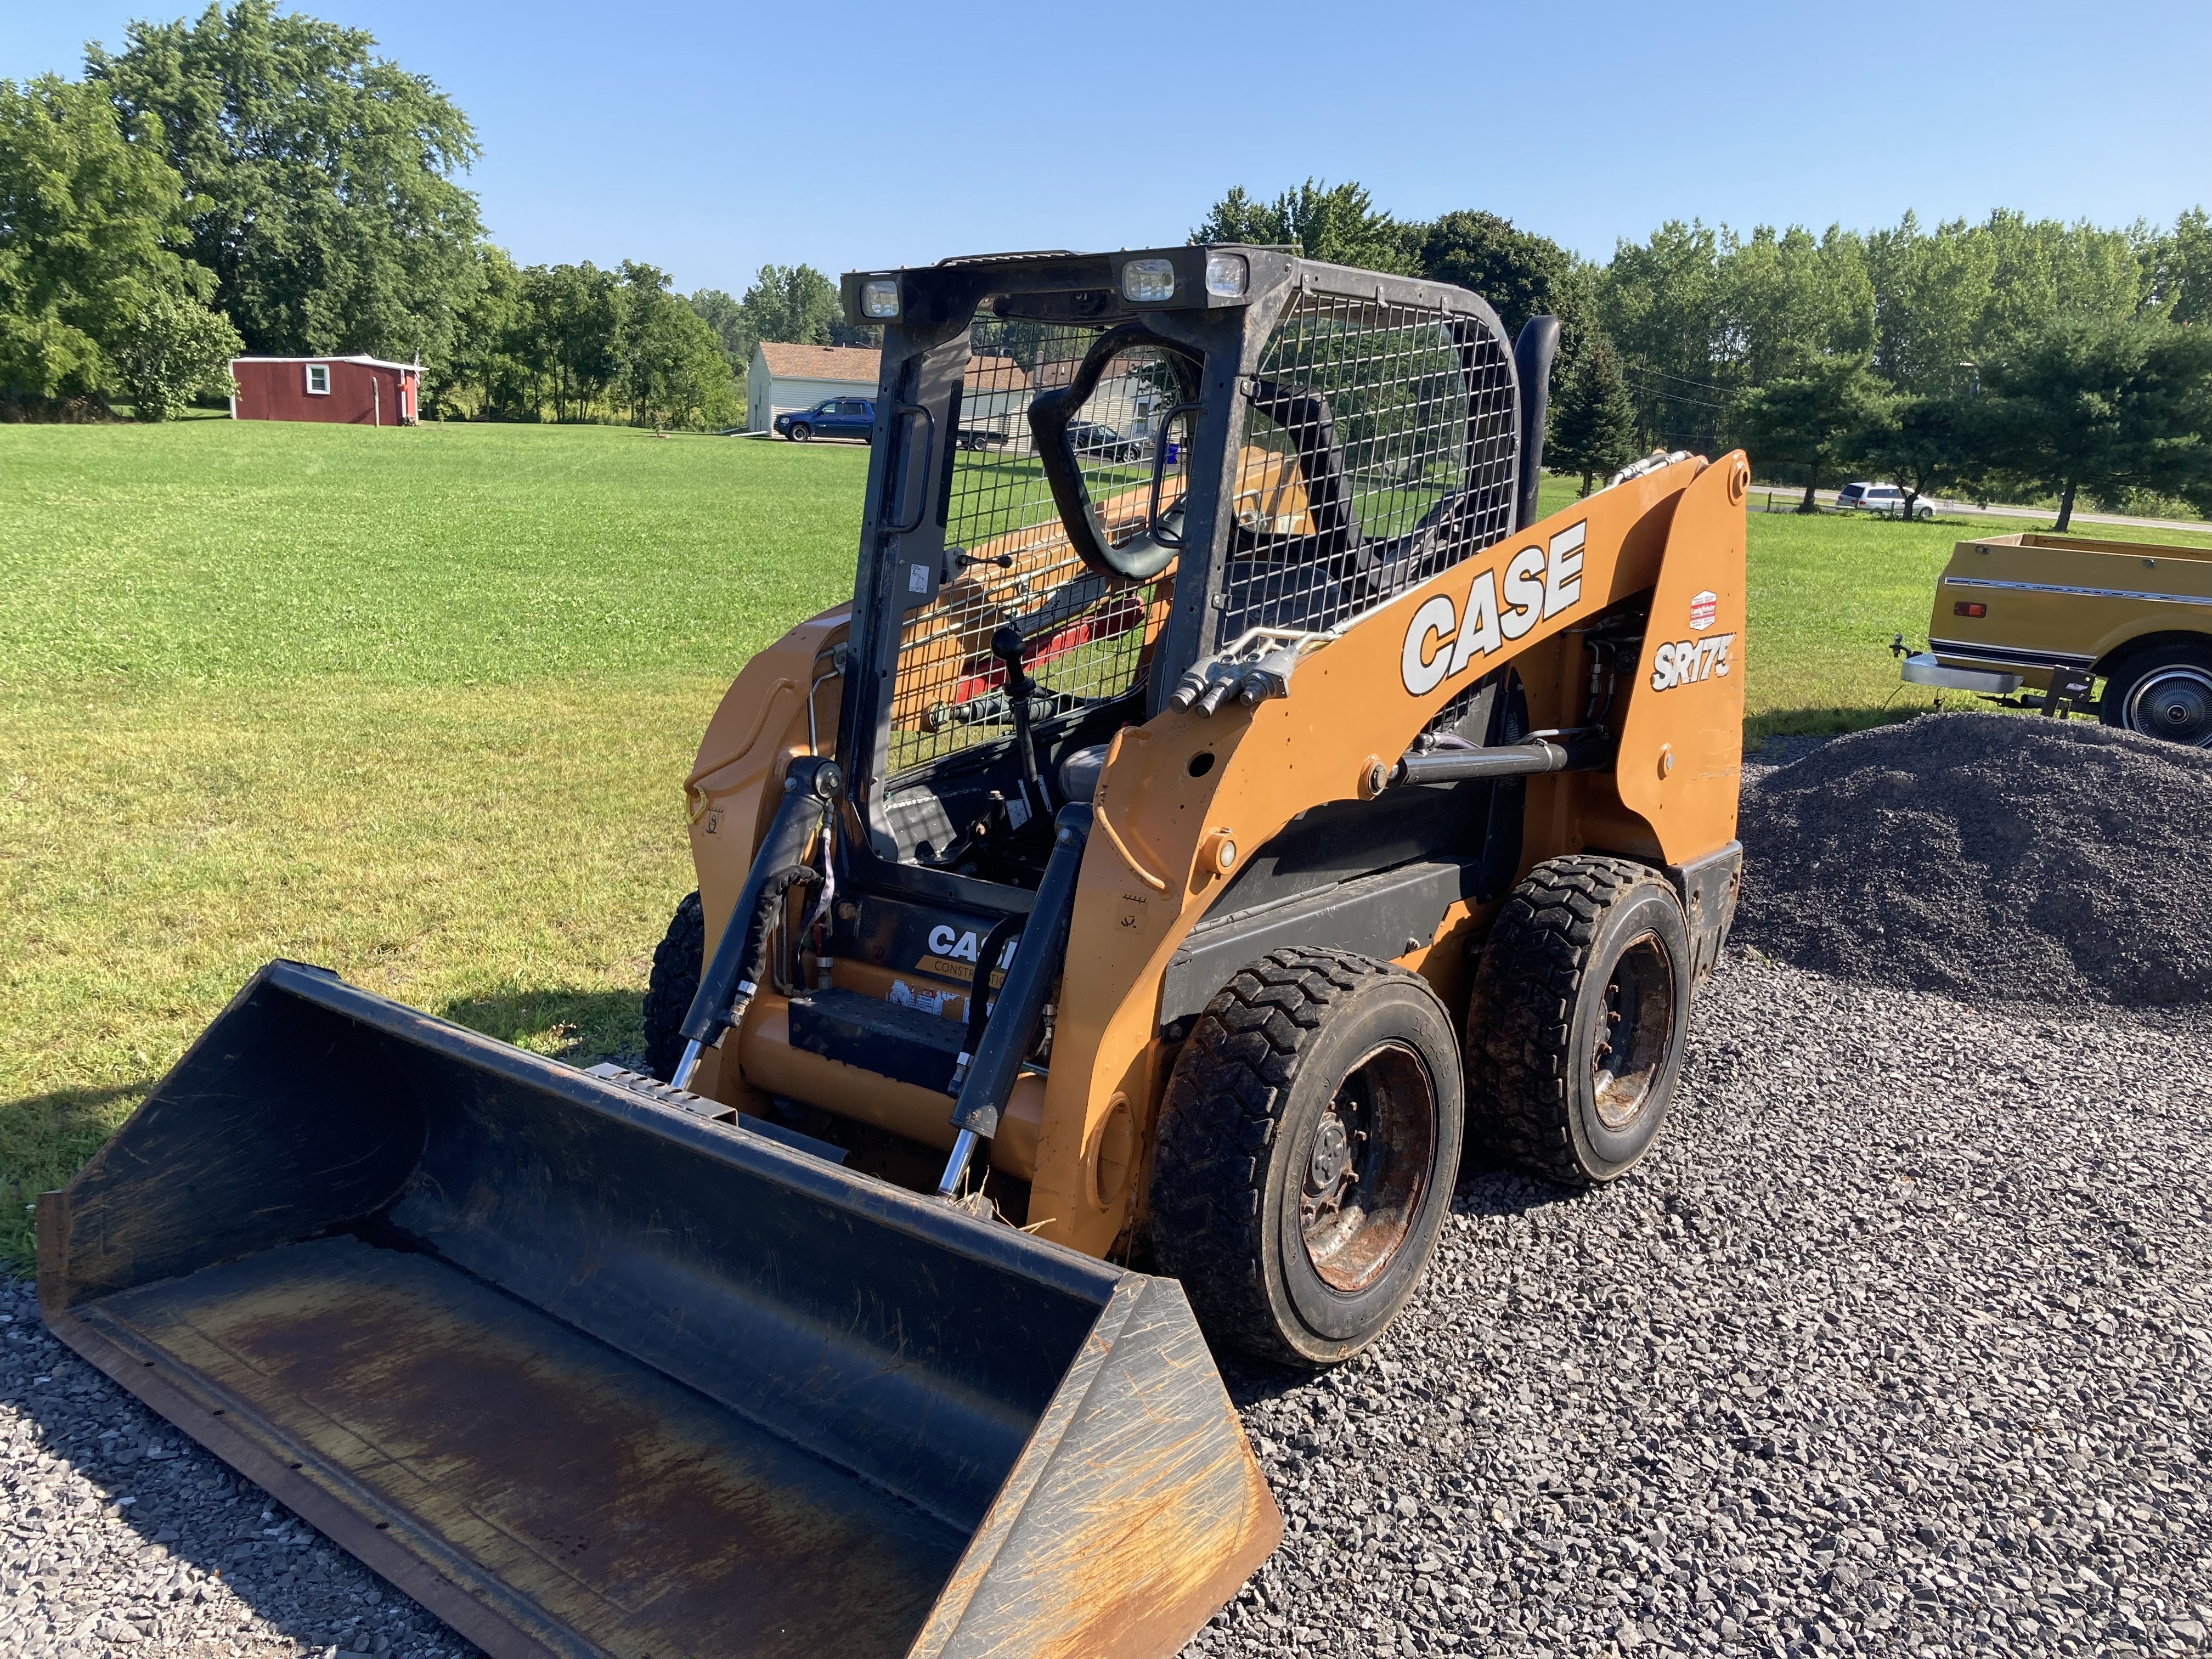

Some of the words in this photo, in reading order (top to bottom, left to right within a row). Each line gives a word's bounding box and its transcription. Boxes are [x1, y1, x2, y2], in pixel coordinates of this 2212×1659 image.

[1401, 518, 1588, 697] CASE
[1650, 632, 1736, 692] SR175
[928, 925, 1018, 969] CA
[935, 961, 1004, 985] CONSTRTI
